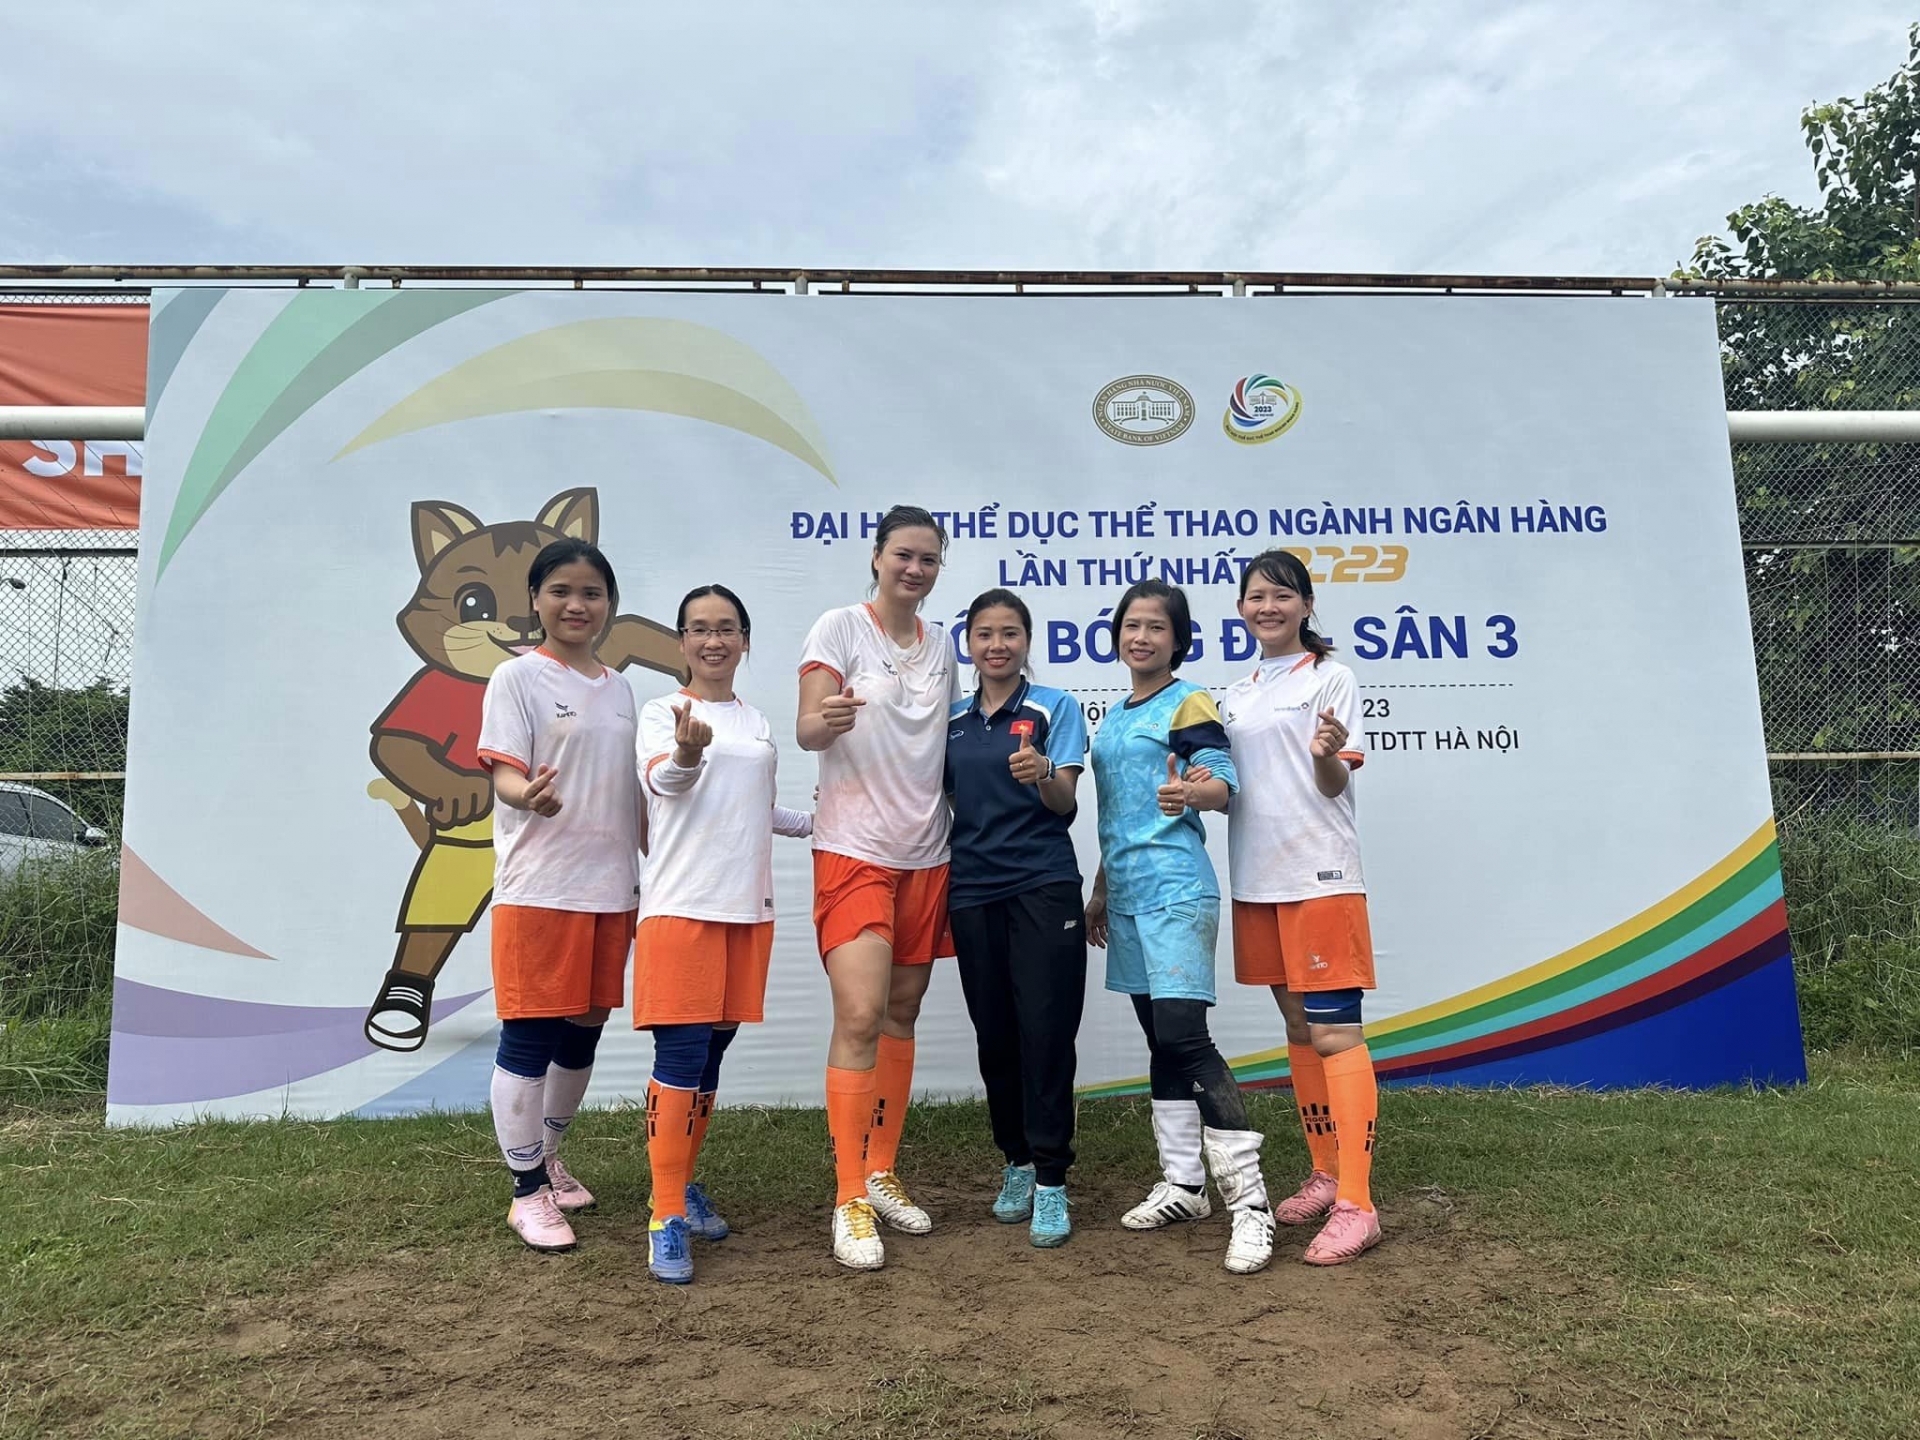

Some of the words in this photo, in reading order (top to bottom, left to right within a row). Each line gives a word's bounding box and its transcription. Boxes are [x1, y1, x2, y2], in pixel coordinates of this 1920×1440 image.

[1123, 432, 1144, 443] BANK
[791, 511, 848, 545] ĐẠI
[934, 502, 1000, 538] THỂ
[1008, 511, 1079, 545] DỤC
[1088, 501, 1157, 538] THỂ
[1164, 509, 1258, 537] THAO
[1269, 501, 1392, 536] NGÀNH
[1403, 500, 1501, 534] NGÂN
[1510, 499, 1607, 533] HÀNG
[999, 550, 1067, 587] LẦN
[1077, 551, 1154, 586] THỨ
[1353, 605, 1469, 660] SÂN
[1485, 615, 1519, 659] 3
[1081, 701, 1106, 726] ội
[1365, 731, 1427, 751] TDTT
[1435, 726, 1471, 750] HÀ
[1477, 725, 1519, 754] NỘI
